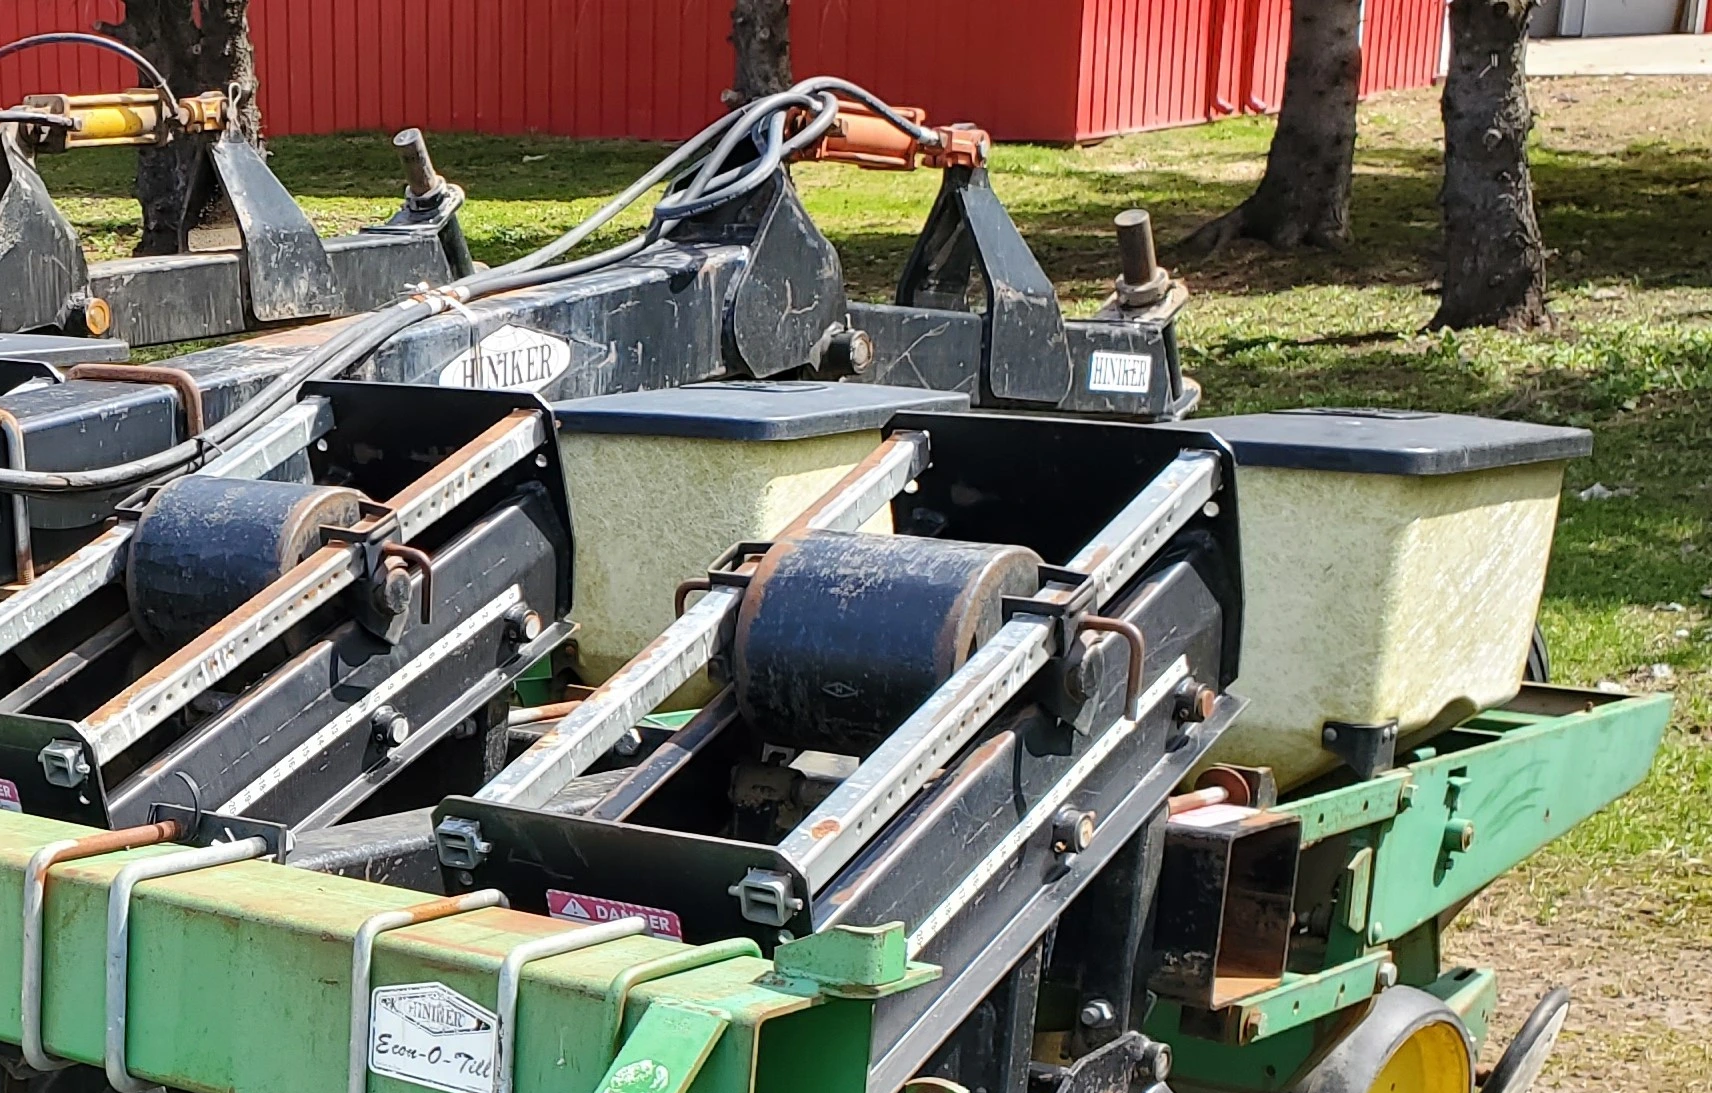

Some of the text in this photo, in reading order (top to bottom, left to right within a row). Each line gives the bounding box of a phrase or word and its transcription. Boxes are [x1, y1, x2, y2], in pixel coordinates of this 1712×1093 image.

[462, 344, 553, 389] HINIKER
[1093, 356, 1147, 387] HINIKER
[375, 1033, 490, 1078] Econ-O-Till
